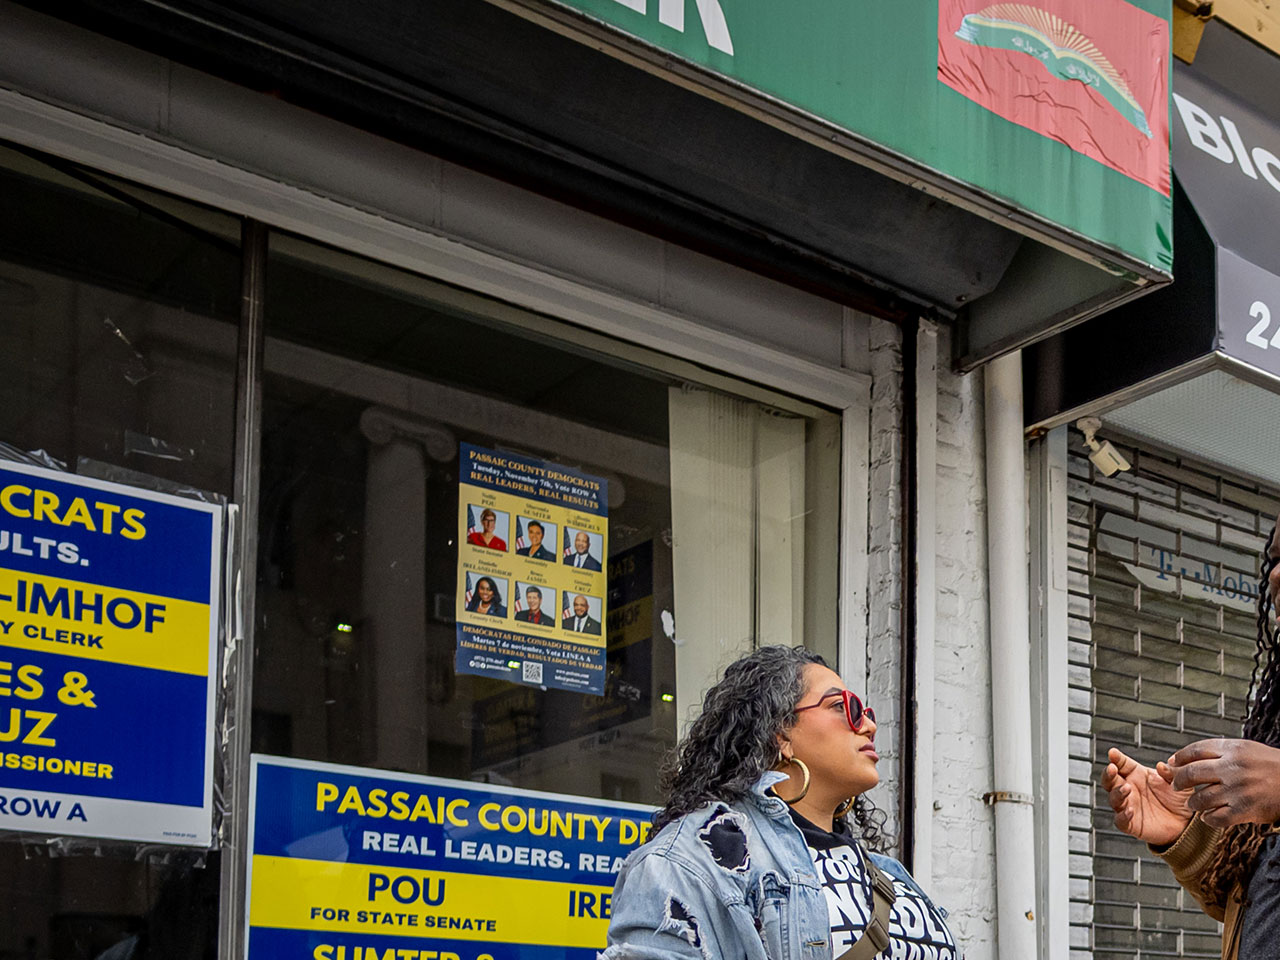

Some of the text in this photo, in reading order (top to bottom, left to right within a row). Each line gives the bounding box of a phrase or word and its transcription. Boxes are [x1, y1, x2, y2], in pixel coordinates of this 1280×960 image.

[470, 450, 600, 491] PASSAIC COUNTY DEMOCRATS
[470, 471, 494, 483] REAL
[539, 488, 561, 500] REAL
[562, 494, 599, 509] RESULTS
[23, 625, 104, 649] CLERK
[57, 671, 98, 708] &
[66, 802, 88, 822] A
[316, 782, 470, 827] PASSAIC
[478, 802, 612, 842] COUNTY
[362, 831, 627, 874] REAL LEADERS. REA
[367, 873, 446, 907] POU
[310, 907, 497, 932] FOR STATE SENATE
